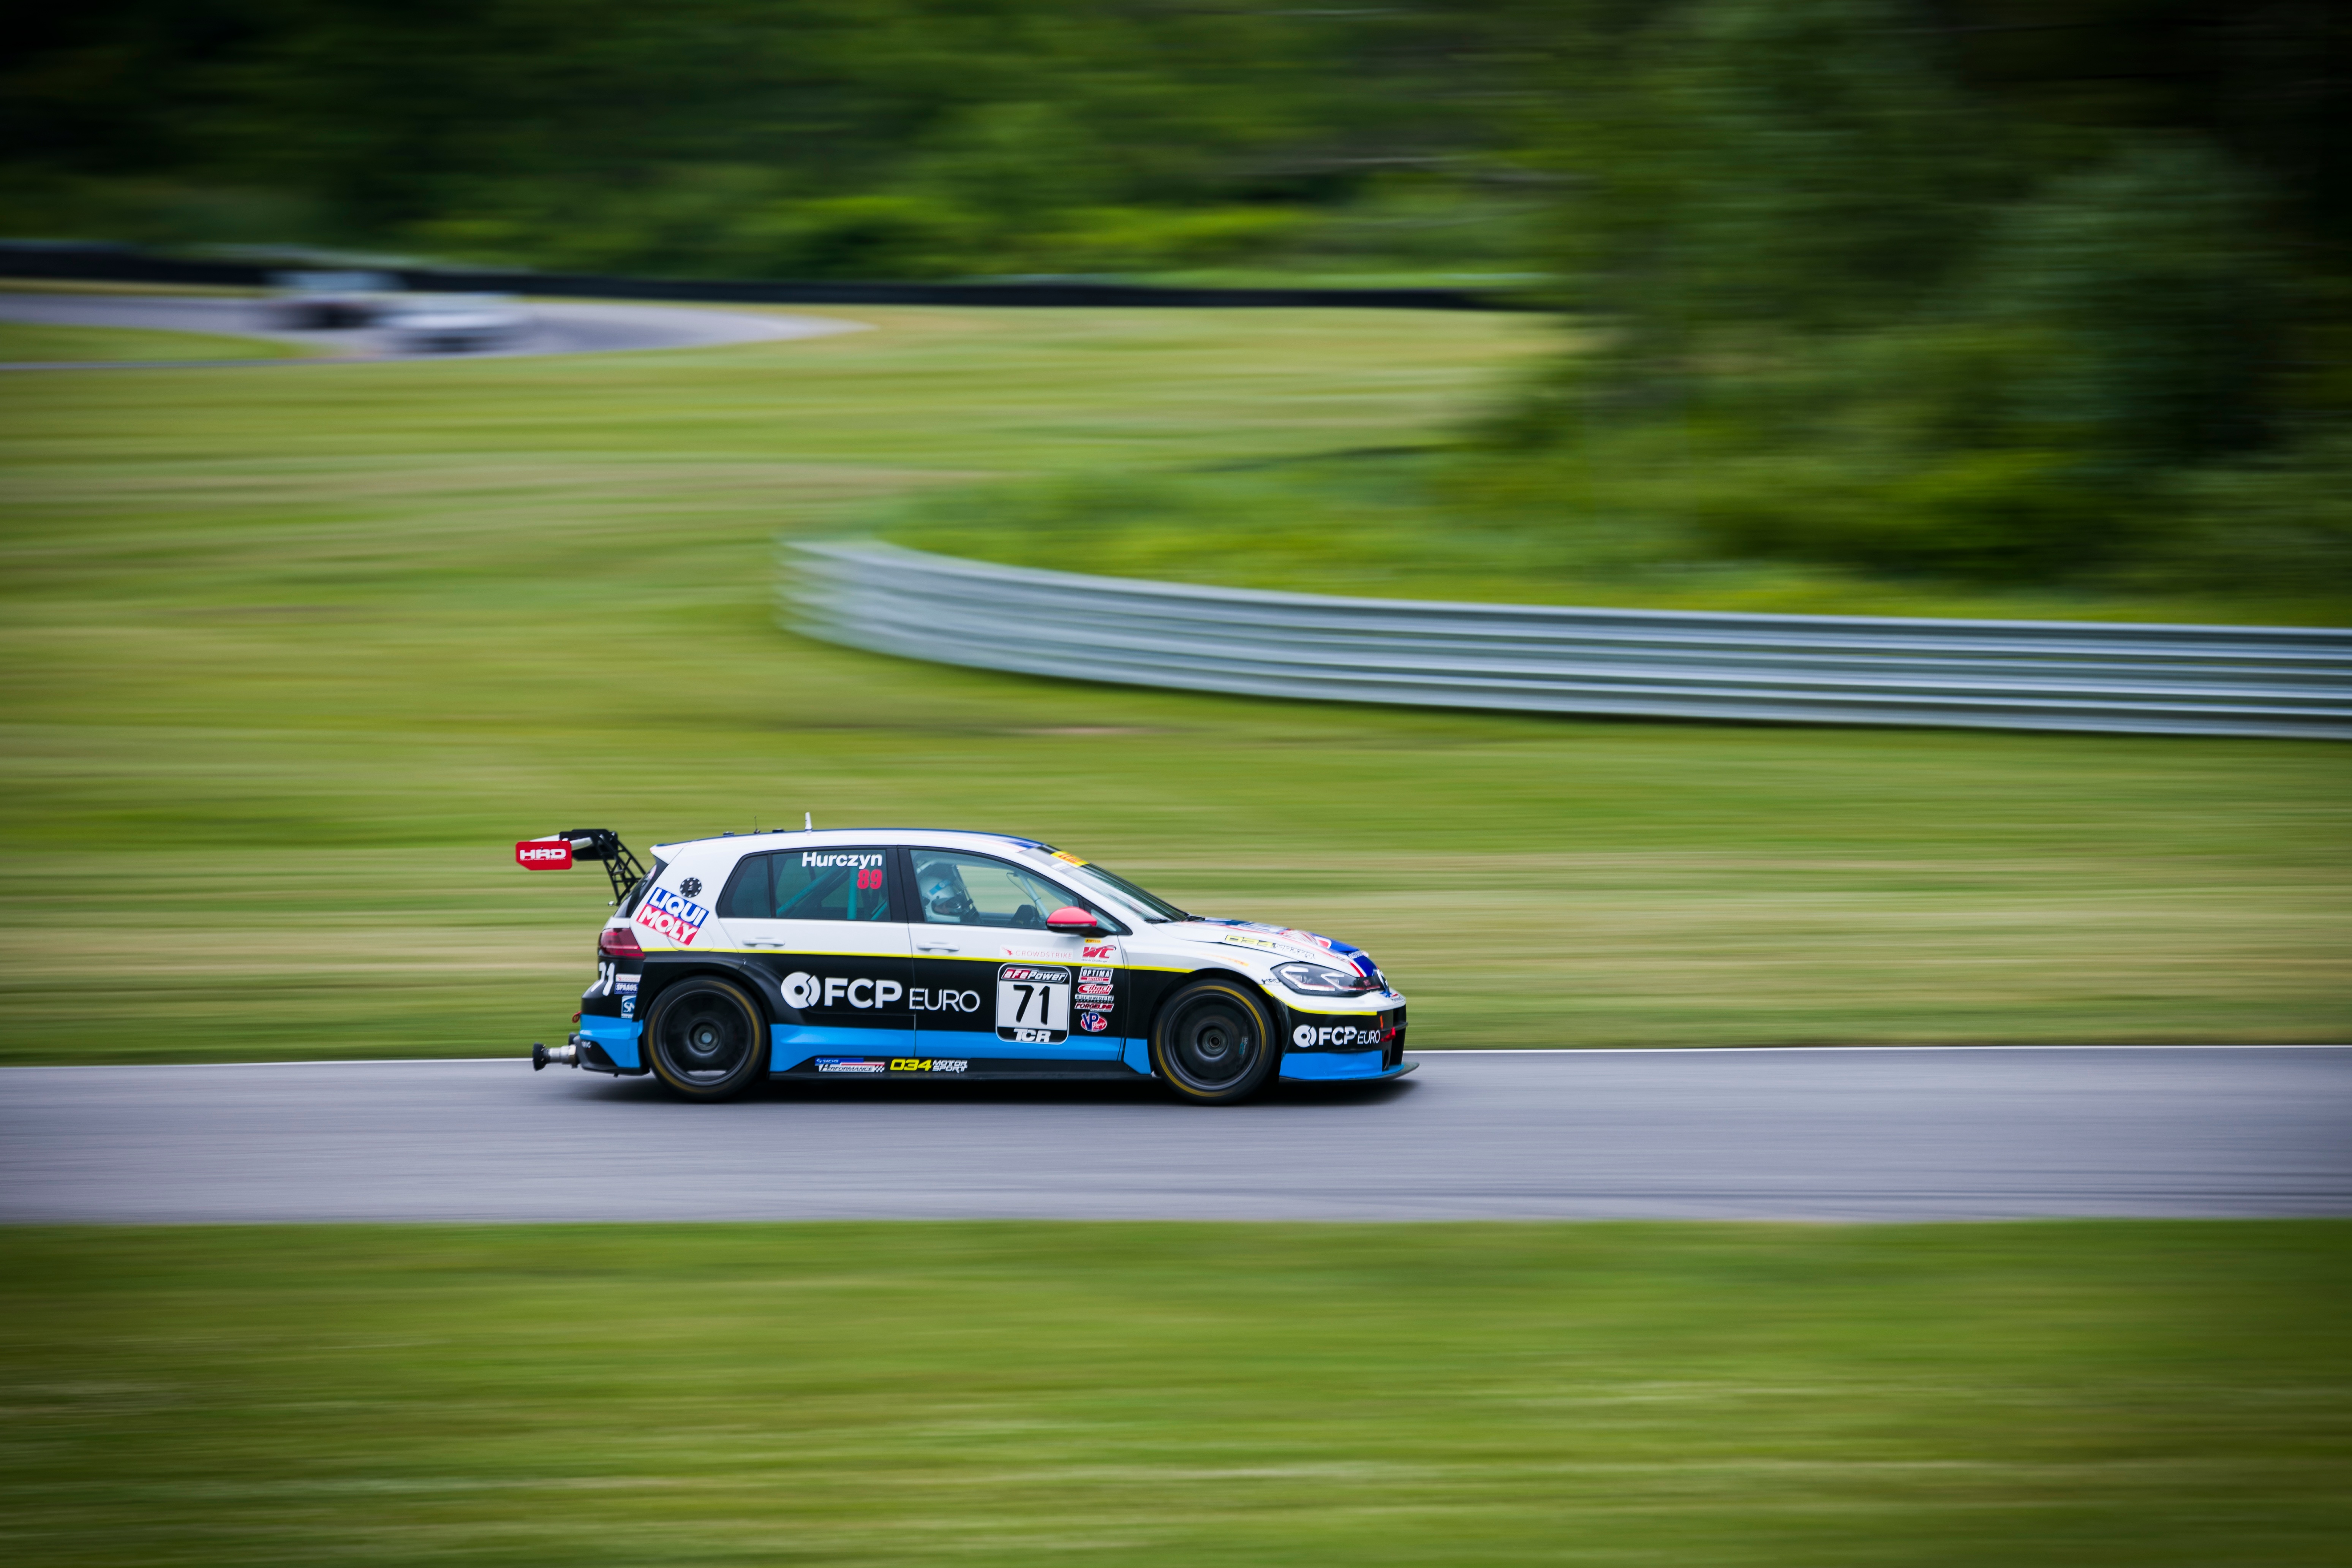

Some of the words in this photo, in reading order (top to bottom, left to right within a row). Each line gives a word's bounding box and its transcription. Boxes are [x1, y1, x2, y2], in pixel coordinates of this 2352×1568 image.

[801, 851, 882, 869] Hurczyn
[857, 869, 882, 889] 89
[649, 888, 707, 926] LIQUI
[638, 906, 698, 943] MOLY
[1015, 950, 1072, 959] CROWDSTRIKE
[1083, 945, 1116, 958] WC
[1083, 969, 1110, 977] OPTIMA
[824, 977, 903, 1008] FCP
[909, 988, 980, 1012] EURO
[1013, 984, 1050, 1026] 71
[1081, 1012, 1100, 1031] VP
[1013, 1028, 1051, 1042] TCR
[1318, 1026, 1357, 1045] FCP
[1357, 1029, 1380, 1045] EURO
[890, 1059, 932, 1071] 034
[933, 1059, 967, 1068] MOTOR
